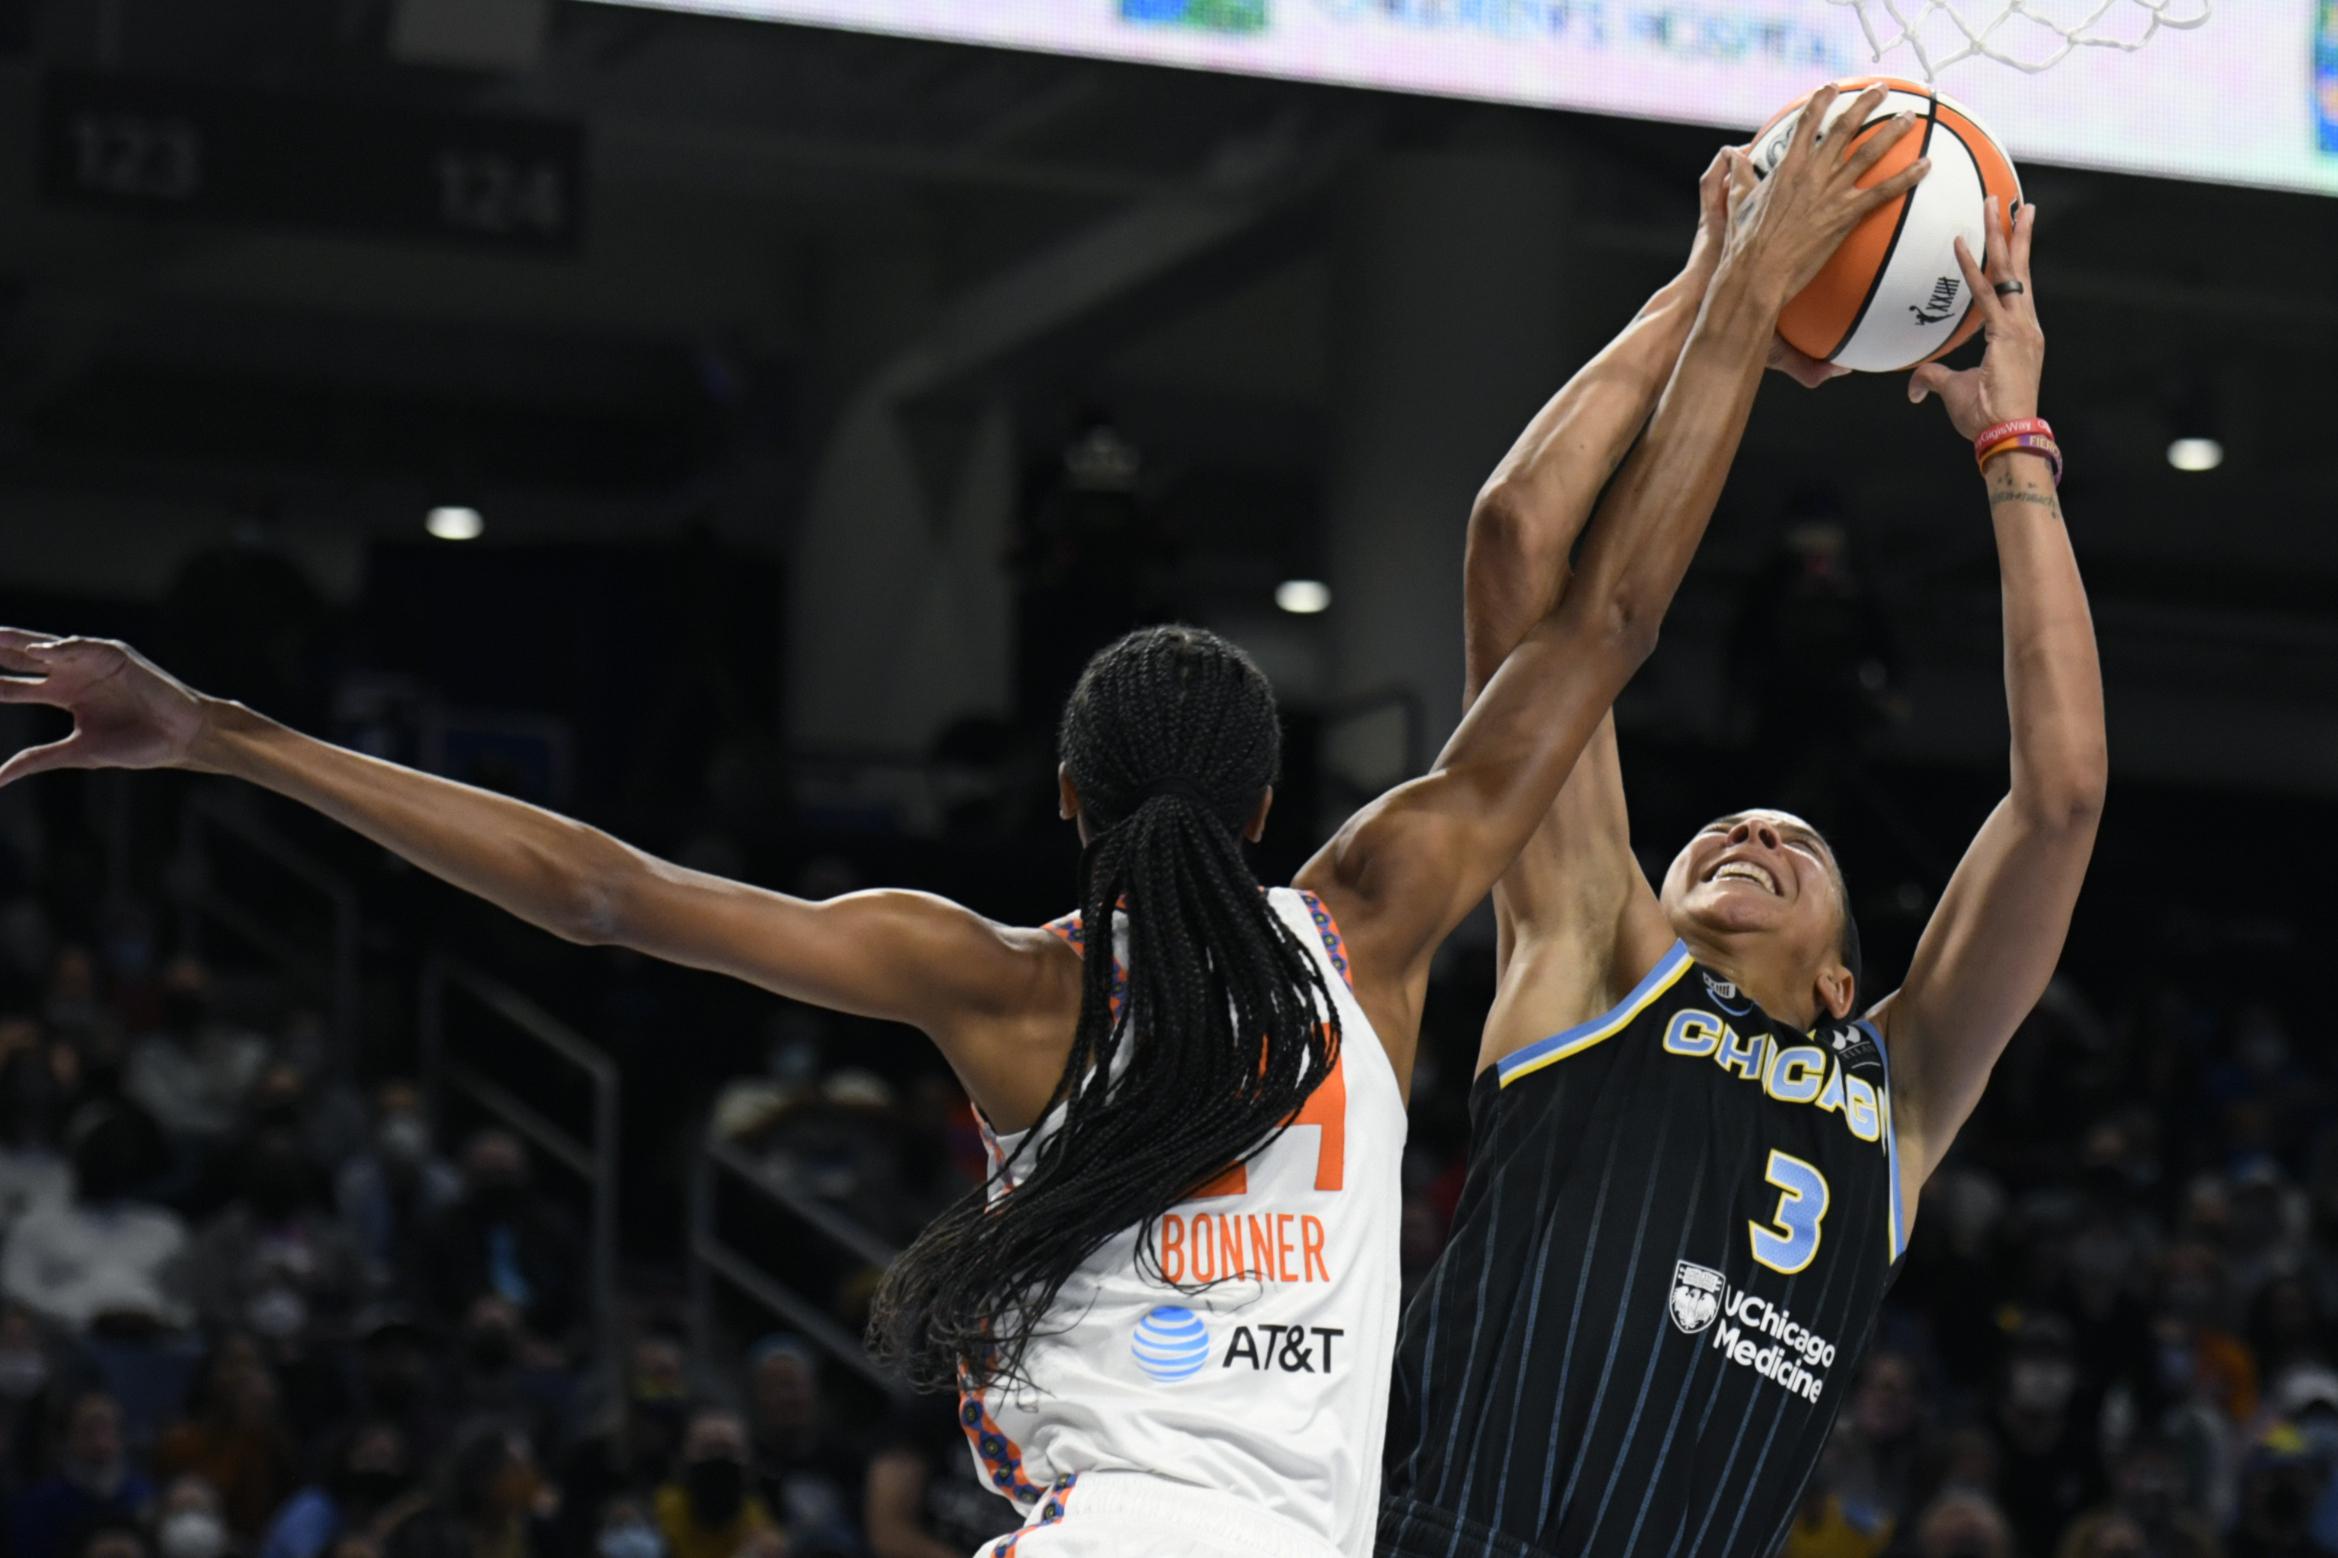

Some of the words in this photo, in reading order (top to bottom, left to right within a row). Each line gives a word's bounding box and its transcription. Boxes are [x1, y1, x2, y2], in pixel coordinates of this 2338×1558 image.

[1160, 1212, 1330, 1285] BONNER
[1748, 1148, 1830, 1275] 3
[1222, 1324, 1345, 1375] AT&T
[1712, 1317, 1824, 1404] Medicine
[1724, 1284, 1836, 1368] UChicago
